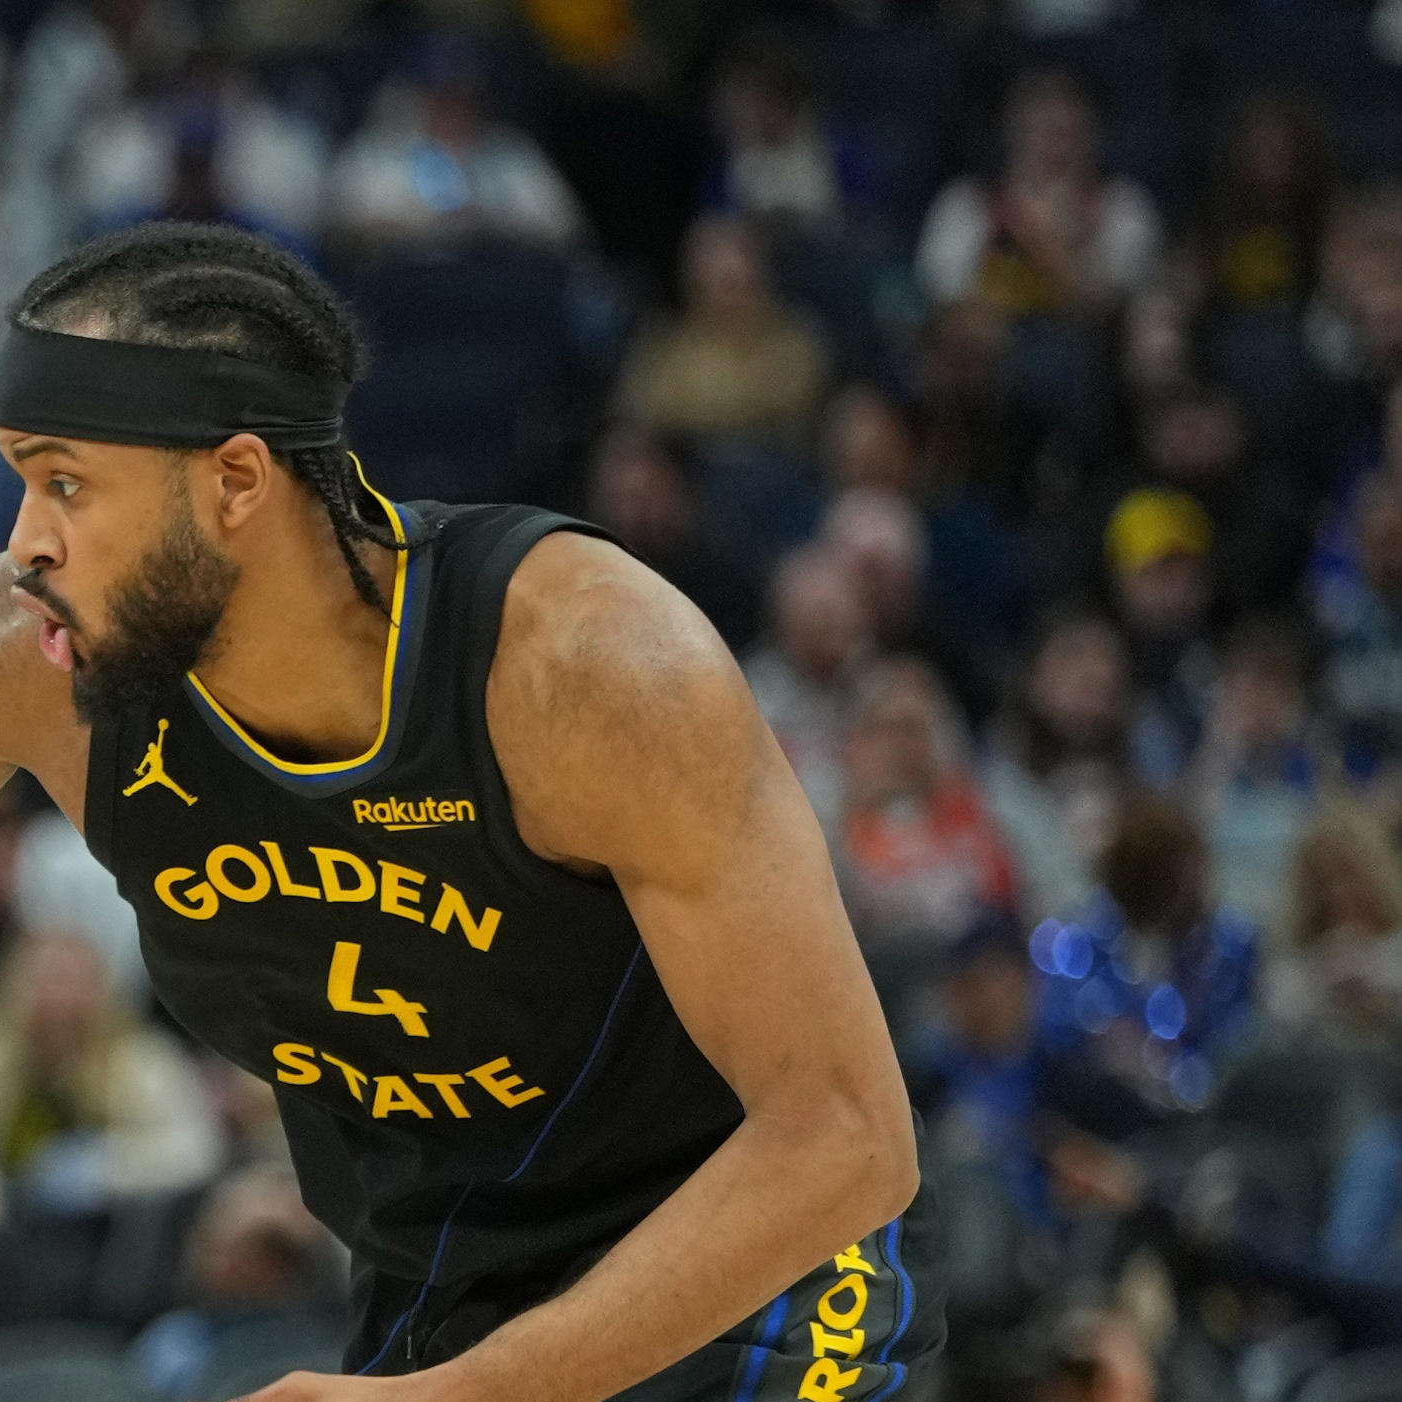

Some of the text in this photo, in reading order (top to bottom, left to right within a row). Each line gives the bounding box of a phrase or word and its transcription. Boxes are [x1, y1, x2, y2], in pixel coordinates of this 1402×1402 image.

[352, 797, 476, 828] Rakuten
[153, 840, 503, 952] GOLDEN
[326, 941, 431, 1038] 4
[272, 1042, 546, 1120] STATE
